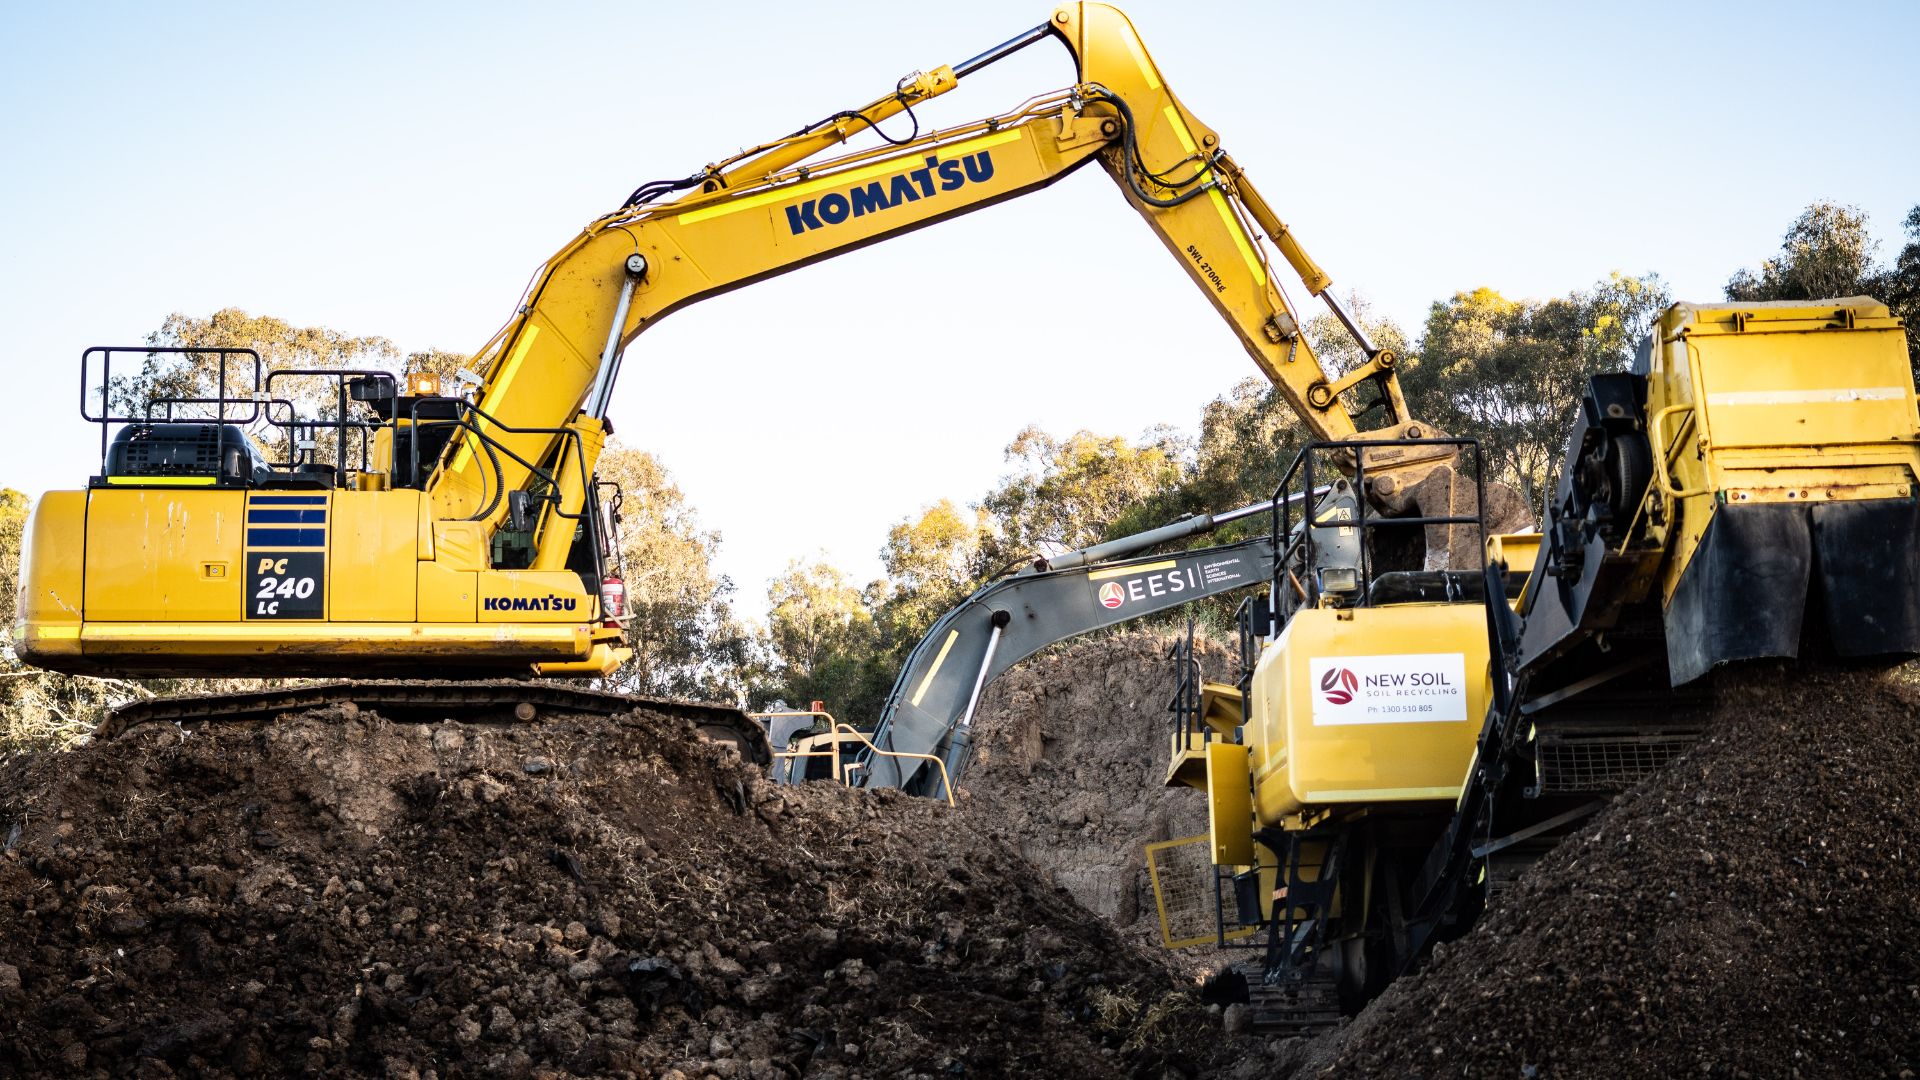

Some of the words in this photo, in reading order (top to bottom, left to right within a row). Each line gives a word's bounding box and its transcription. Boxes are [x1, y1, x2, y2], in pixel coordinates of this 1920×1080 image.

[785, 150, 995, 235] KOMATSU
[1187, 245, 1202, 264] SWL
[1201, 262, 1226, 293] 2700kg
[258, 558, 288, 574] PC
[256, 577, 315, 599] 240
[1128, 568, 1196, 602] EESI
[257, 601, 279, 614] LC
[484, 594, 576, 611] KOMATSU
[1366, 674, 1406, 687] NEW
[1410, 672, 1450, 686] SOIL
[1396, 688, 1458, 696] RECYCLING
[1418, 704, 1432, 712] 805
